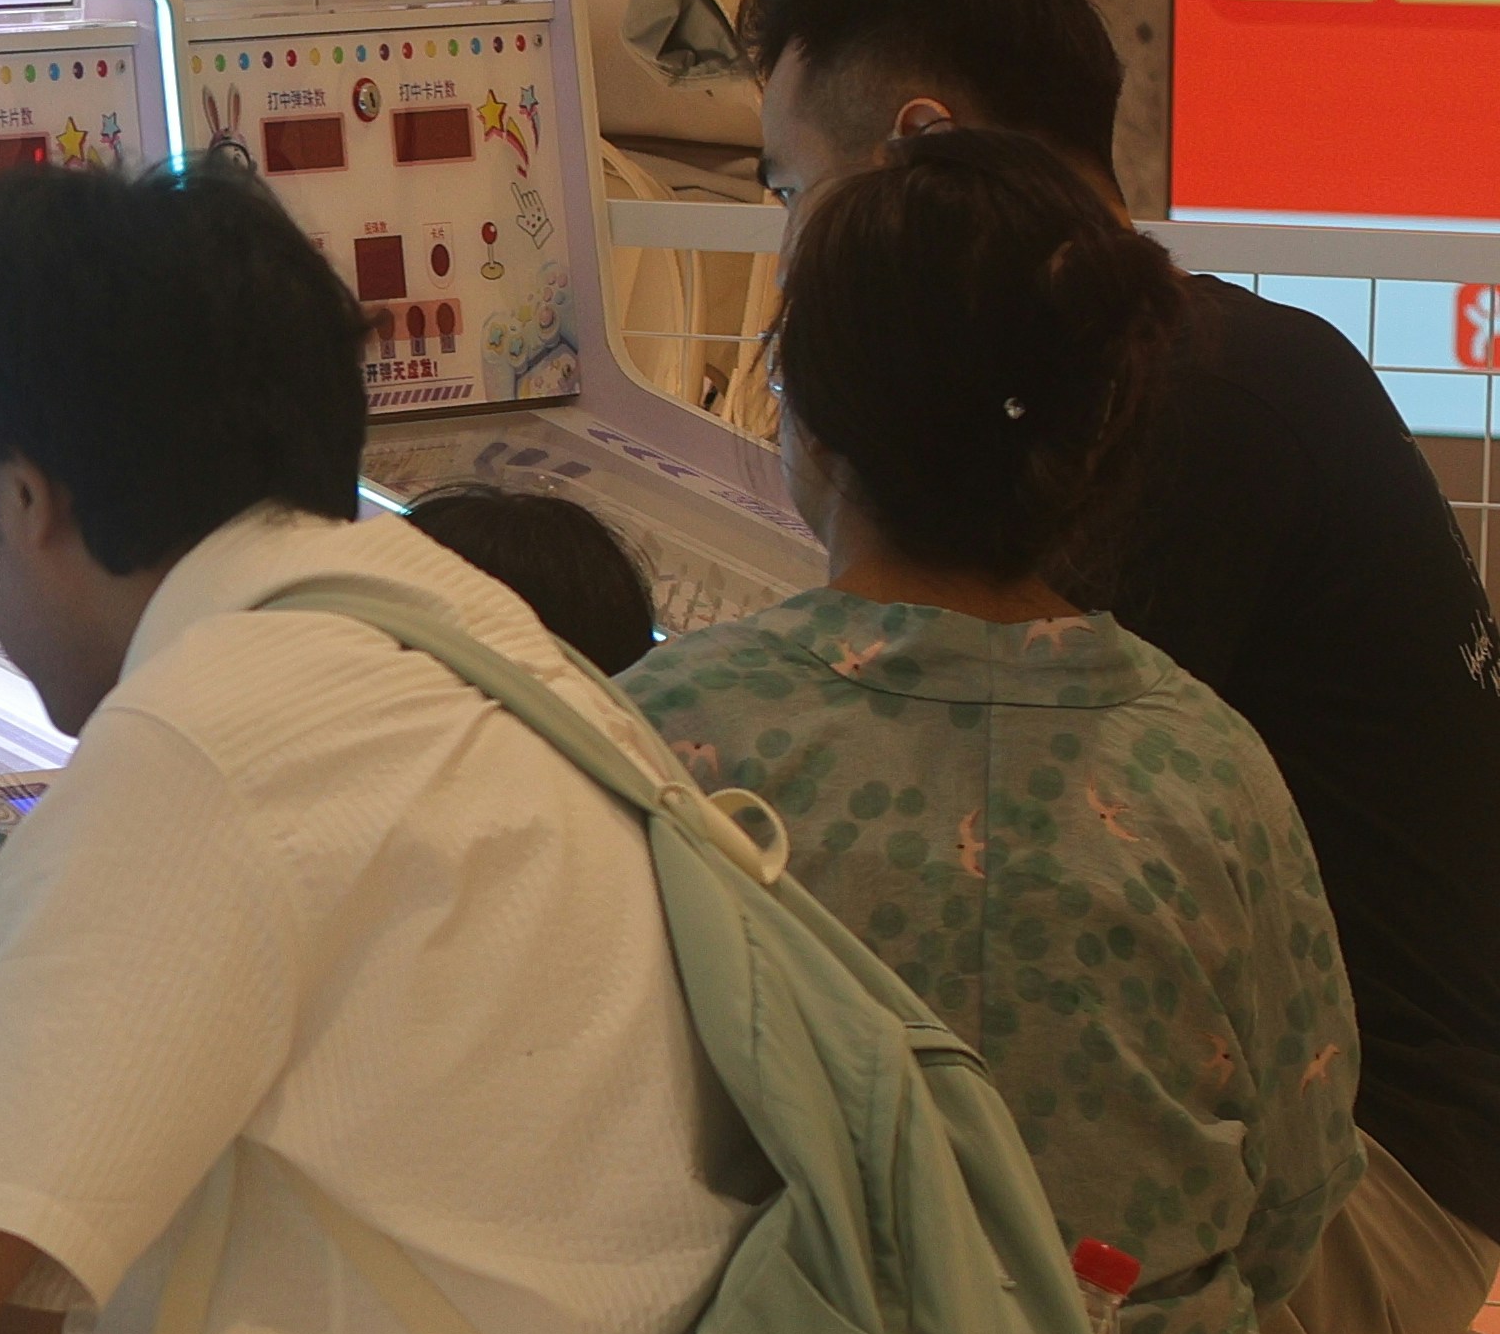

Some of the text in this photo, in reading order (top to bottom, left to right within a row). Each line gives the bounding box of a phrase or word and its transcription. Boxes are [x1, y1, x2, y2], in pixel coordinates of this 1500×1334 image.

[267, 88, 326, 113] 打中弹珠数
[399, 80, 457, 103] 打中卡片数
[365, 359, 439, 384] 开弹无虚发!
